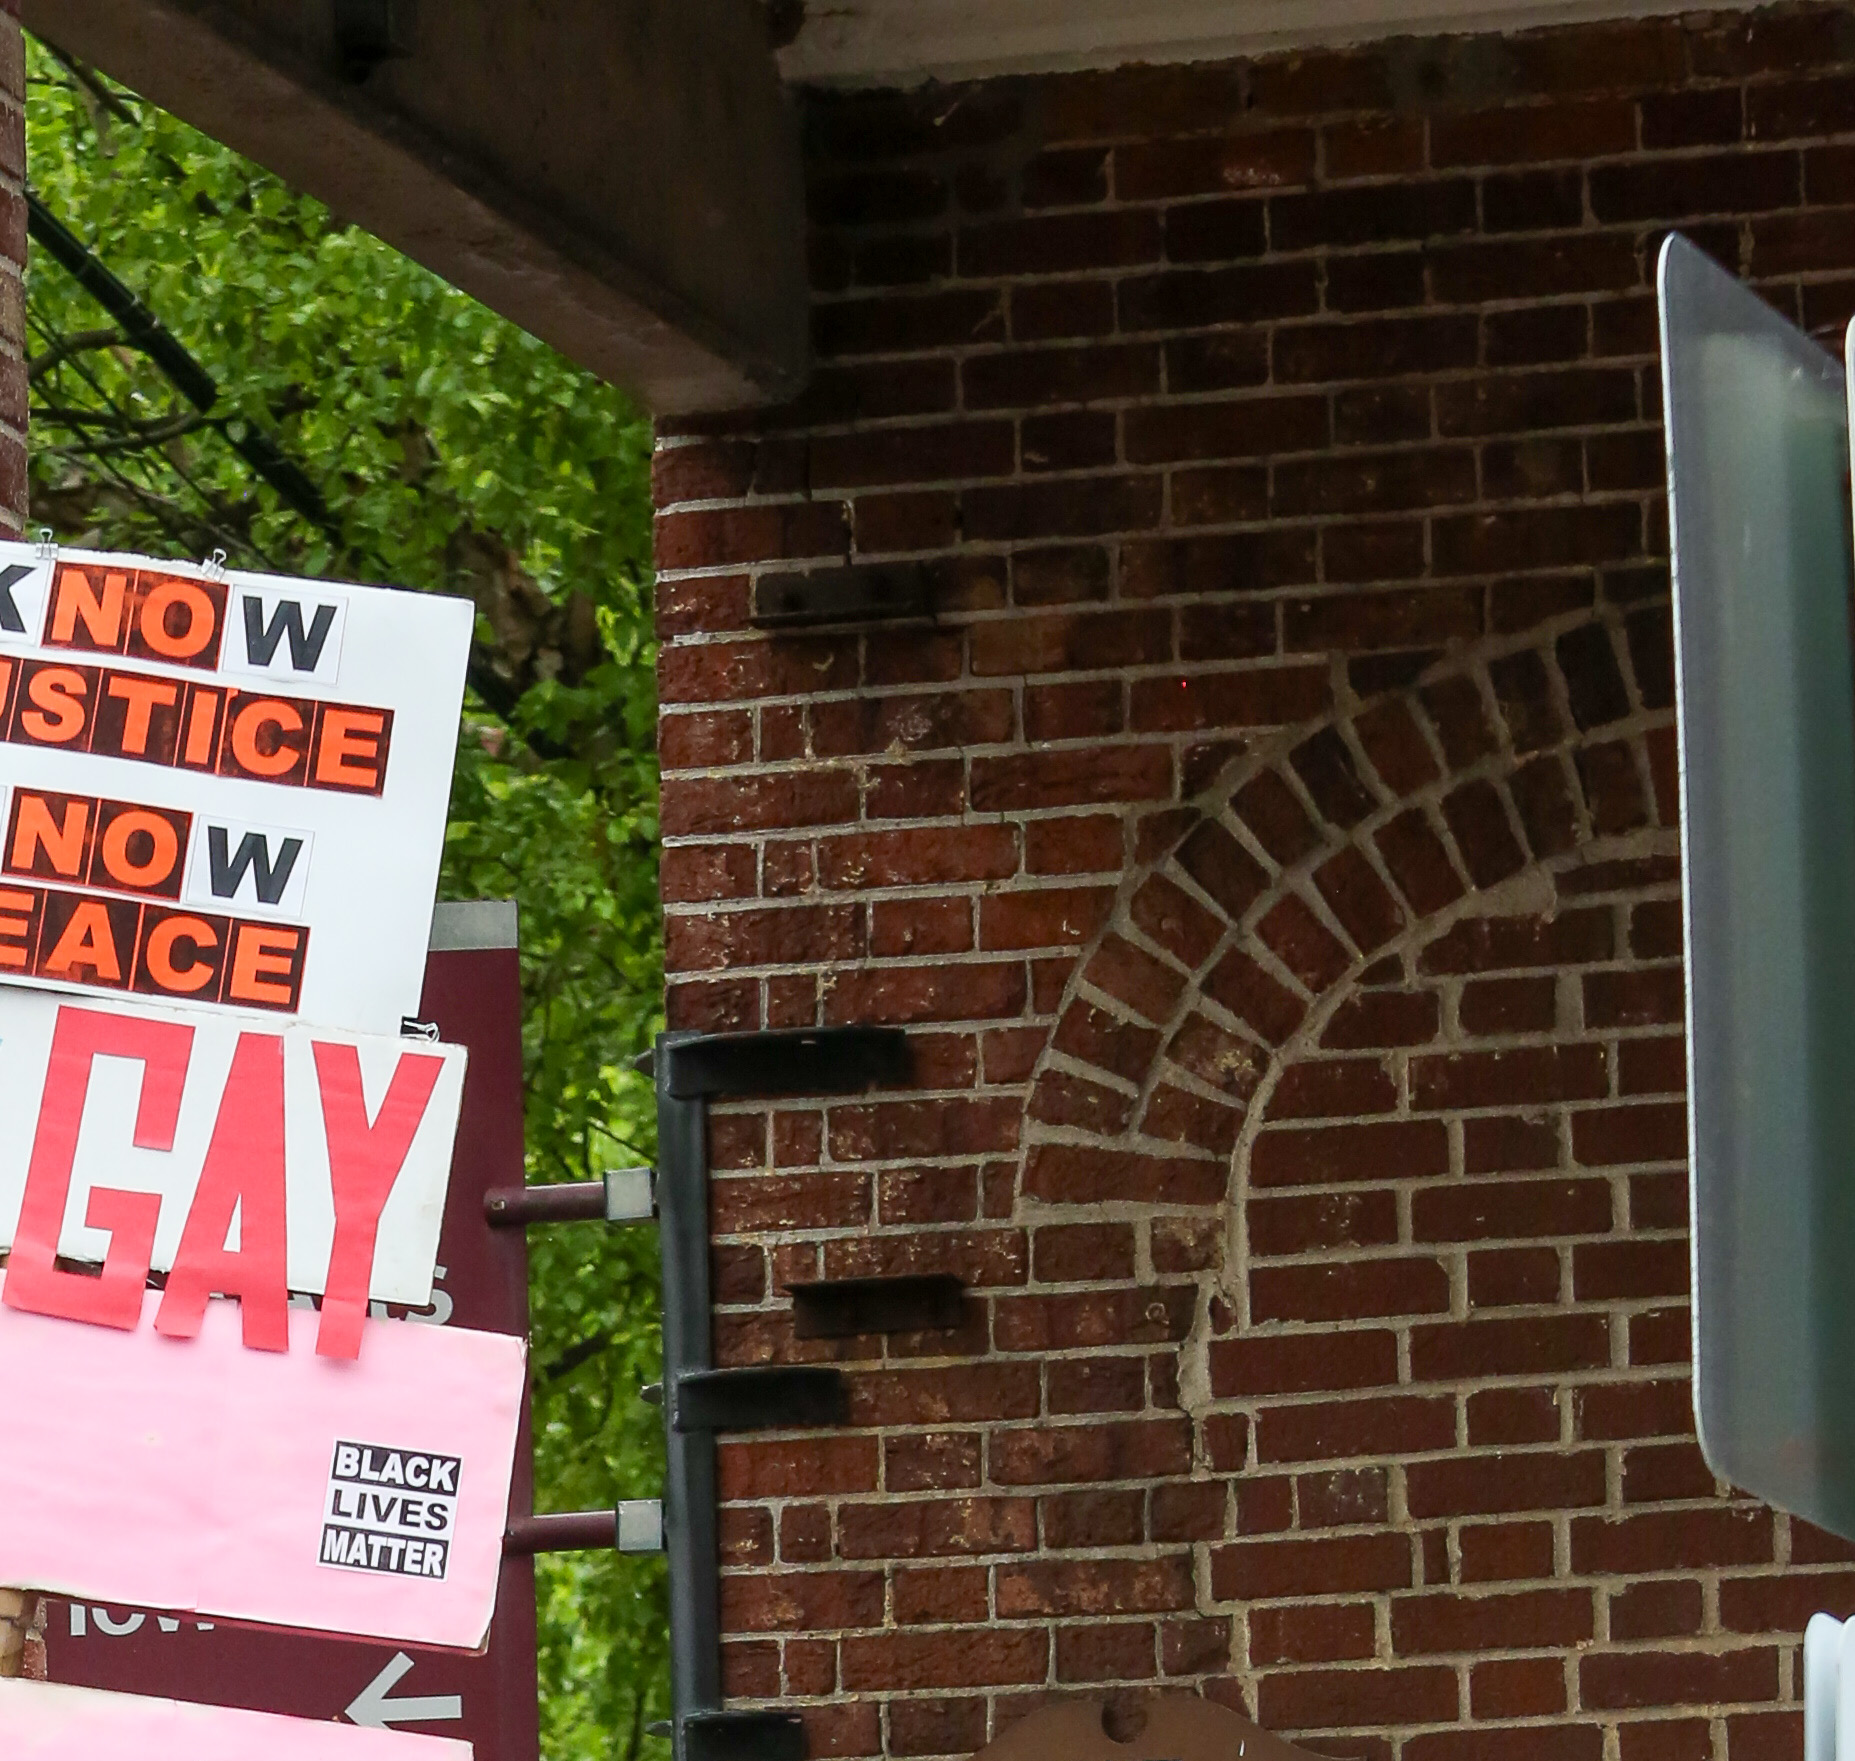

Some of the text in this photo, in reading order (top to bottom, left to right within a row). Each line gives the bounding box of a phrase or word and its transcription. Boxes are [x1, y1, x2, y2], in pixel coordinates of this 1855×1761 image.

[3, 1005, 446, 1360] GAY
[336, 1446, 457, 1492] BLACK
[332, 1489, 449, 1531] LIVES
[323, 1529, 445, 1576] MATTER
